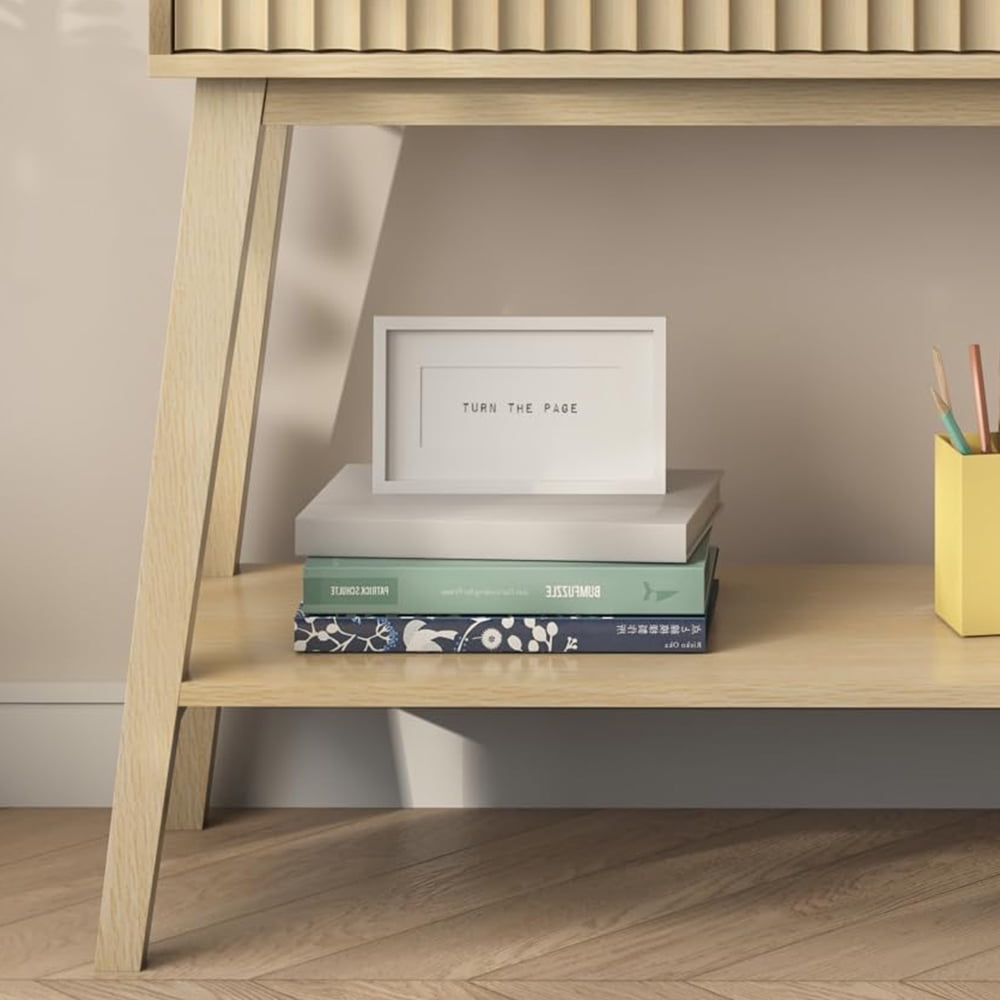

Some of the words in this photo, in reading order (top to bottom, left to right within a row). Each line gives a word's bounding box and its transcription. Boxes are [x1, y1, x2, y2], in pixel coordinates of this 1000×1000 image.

[462, 402, 497, 414] TURN
[508, 402, 533, 414] THE
[544, 402, 579, 414] PAGE
